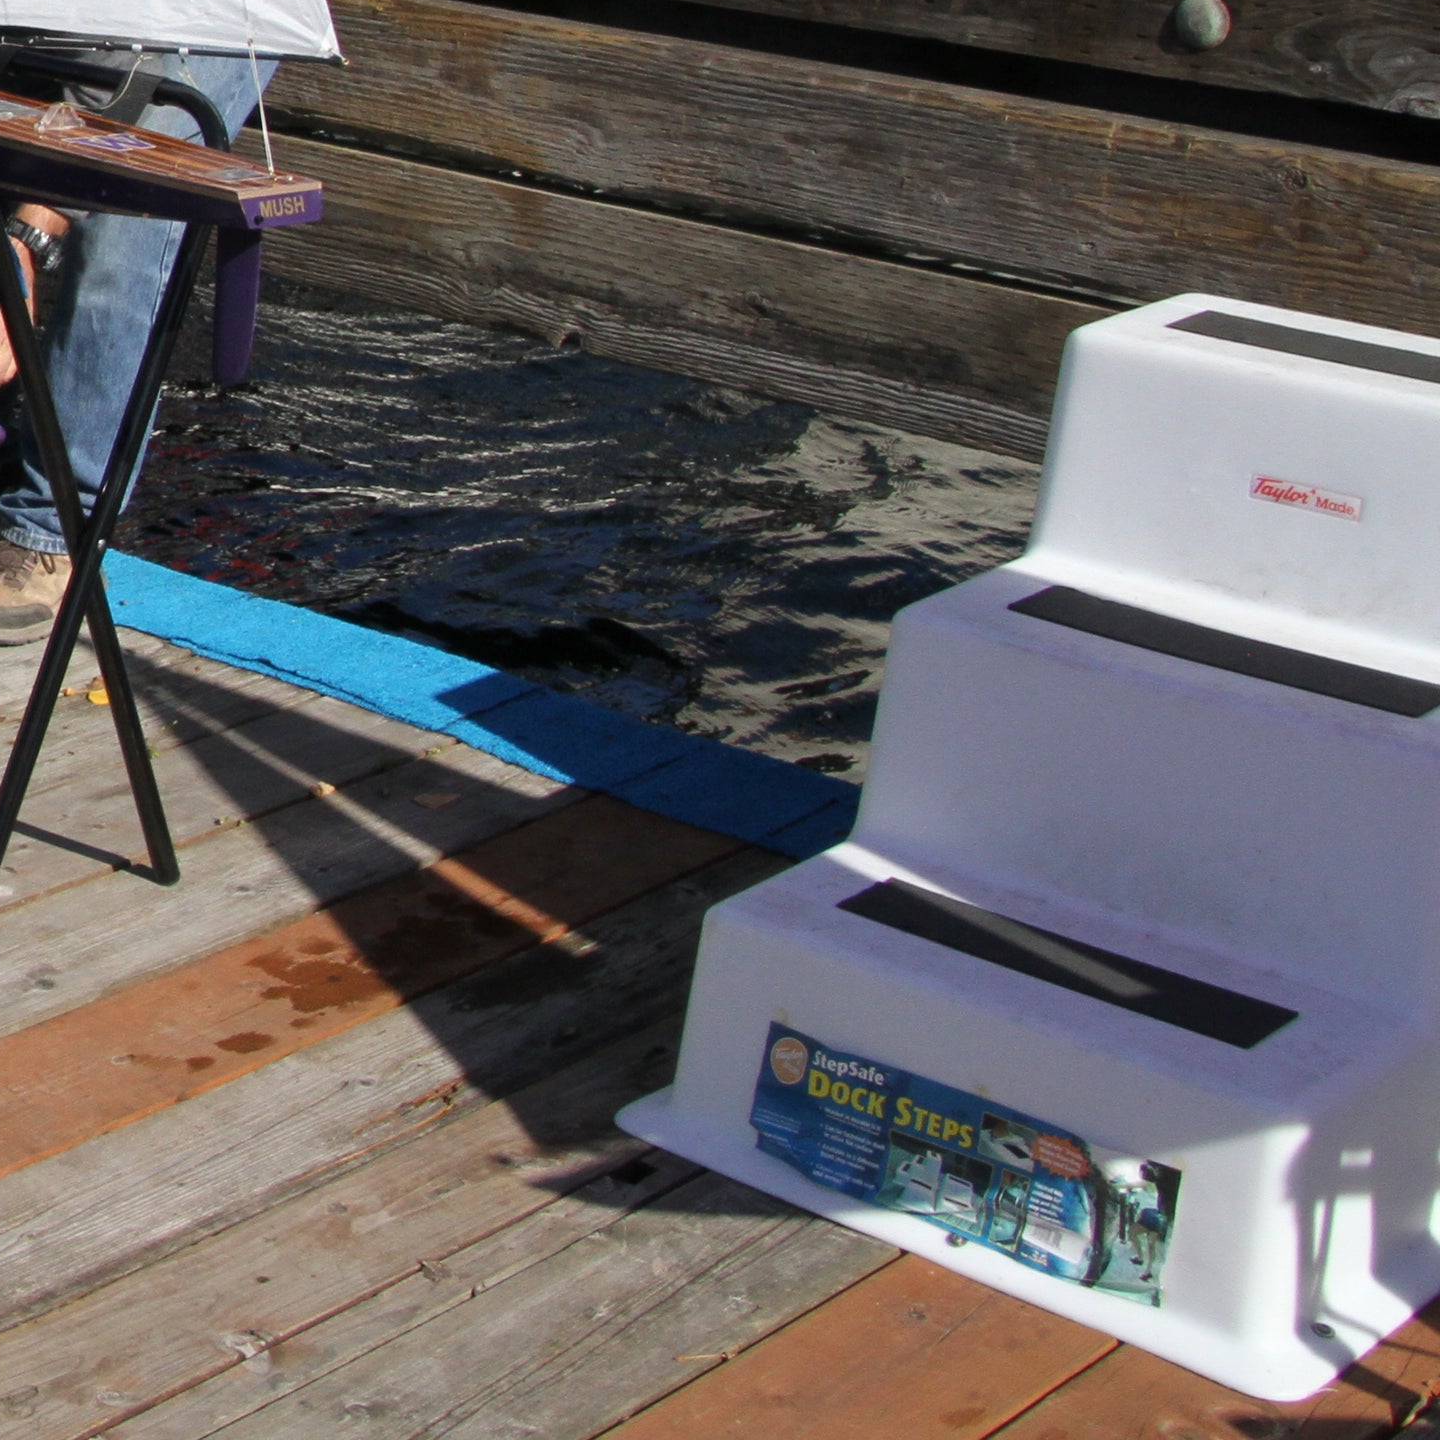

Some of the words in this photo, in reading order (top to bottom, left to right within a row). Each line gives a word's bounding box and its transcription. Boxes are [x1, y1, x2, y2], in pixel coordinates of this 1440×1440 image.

[260, 195, 306, 218] MUSH
[1253, 477, 1308, 503] Taylor
[1315, 496, 1355, 515] Made
[812, 1050, 885, 1086] StepSafe
[807, 1069, 888, 1119] DOCK
[893, 1096, 974, 1148] STEPS
